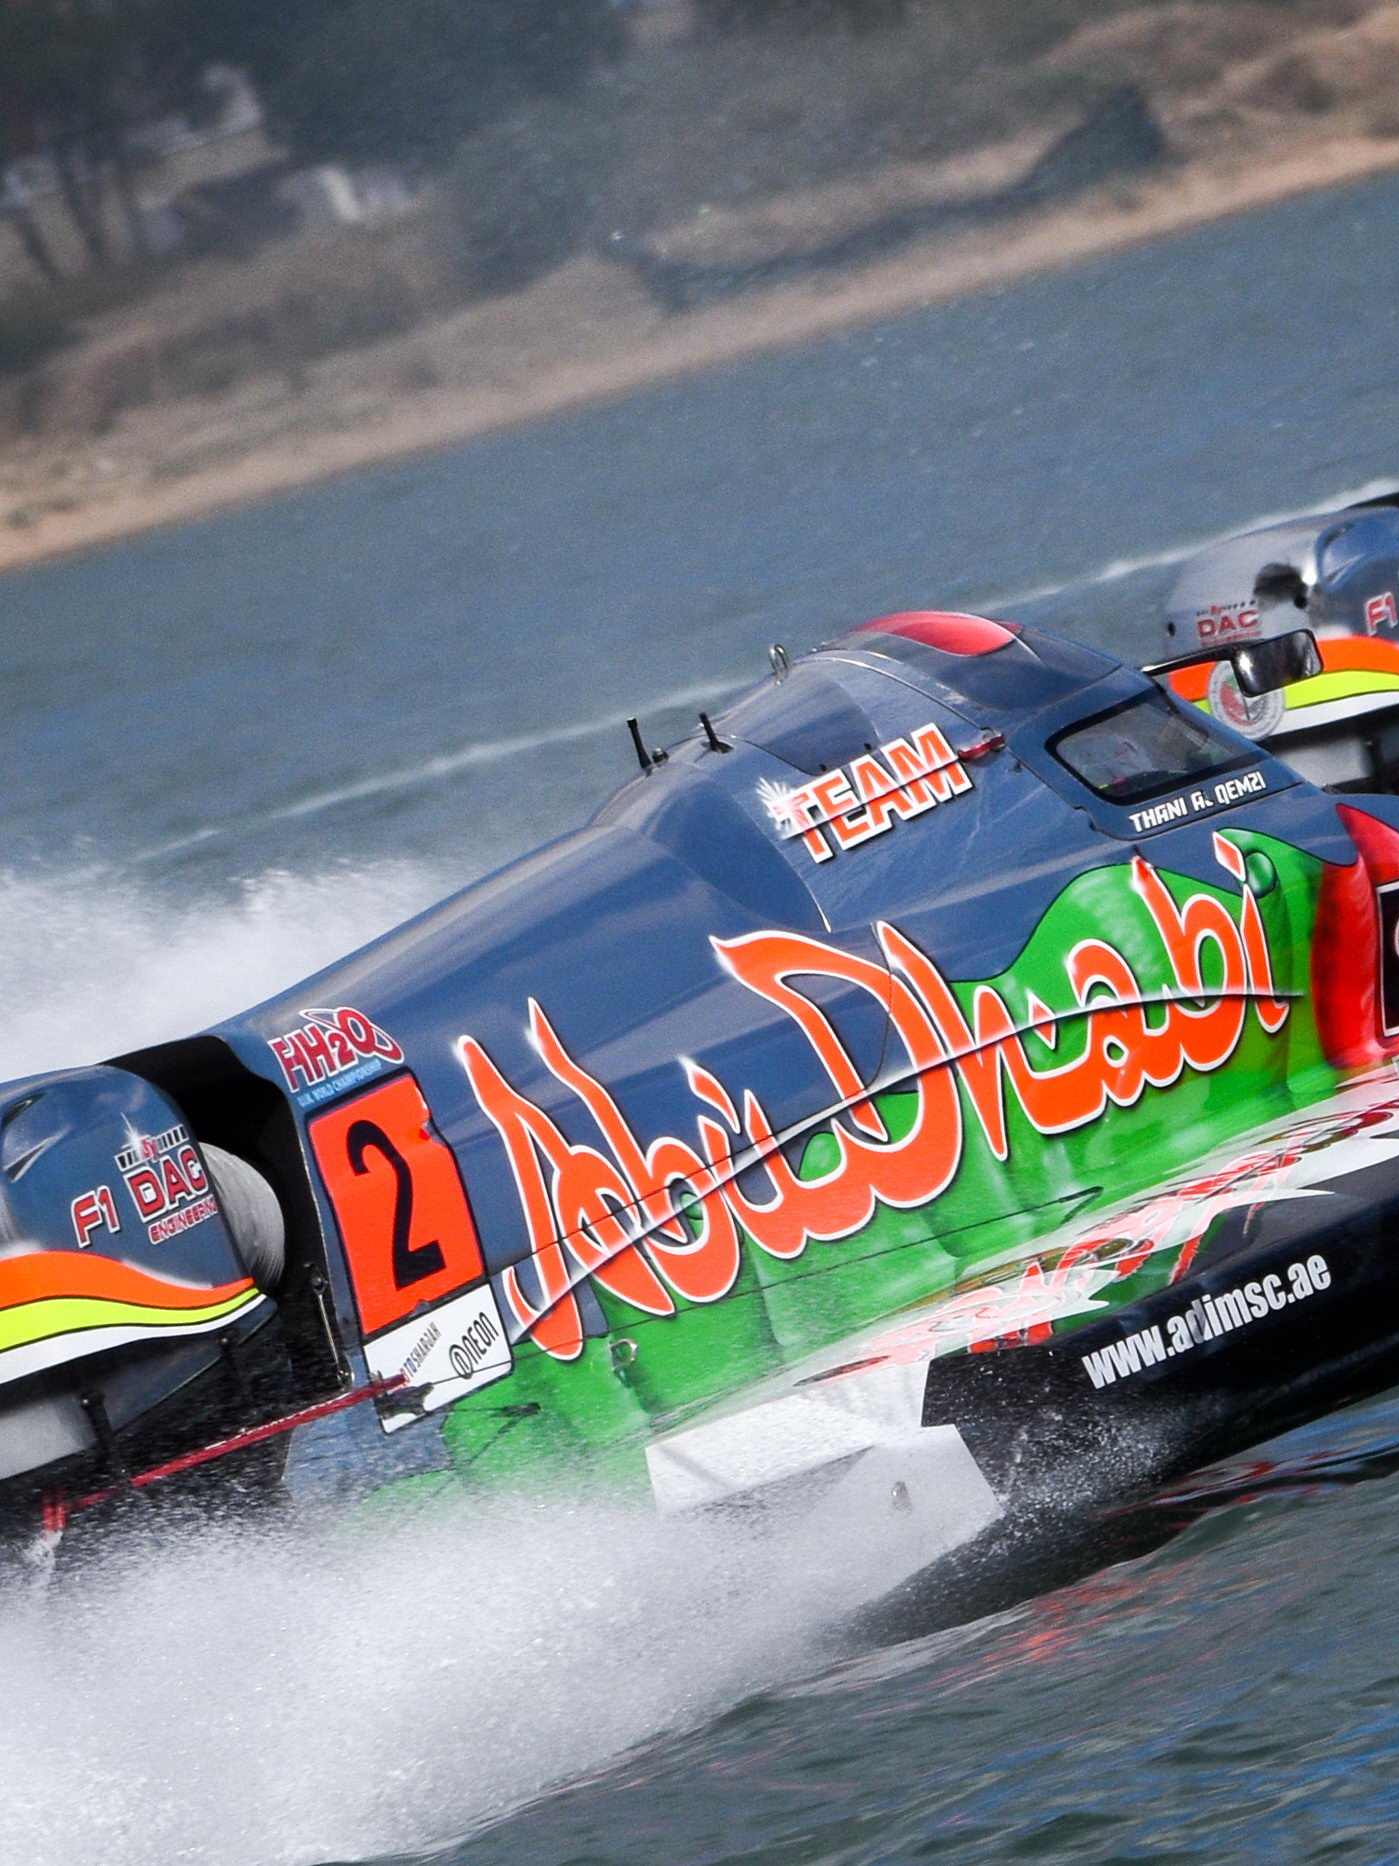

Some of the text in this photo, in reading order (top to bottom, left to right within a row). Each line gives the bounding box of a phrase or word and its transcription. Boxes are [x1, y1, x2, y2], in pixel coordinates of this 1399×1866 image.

[1196, 609, 1260, 639] DAC
[1365, 592, 1398, 635] F1
[774, 722, 972, 864] TEAM
[1128, 796, 1188, 833] THANI
[1214, 770, 1267, 806] QEMZI
[457, 827, 1290, 1362] Abu Dhabi
[71, 1144, 209, 1249] F1 DAC
[345, 1118, 447, 1293] 2
[1081, 1253, 1332, 1390] www.adimsc.ae
